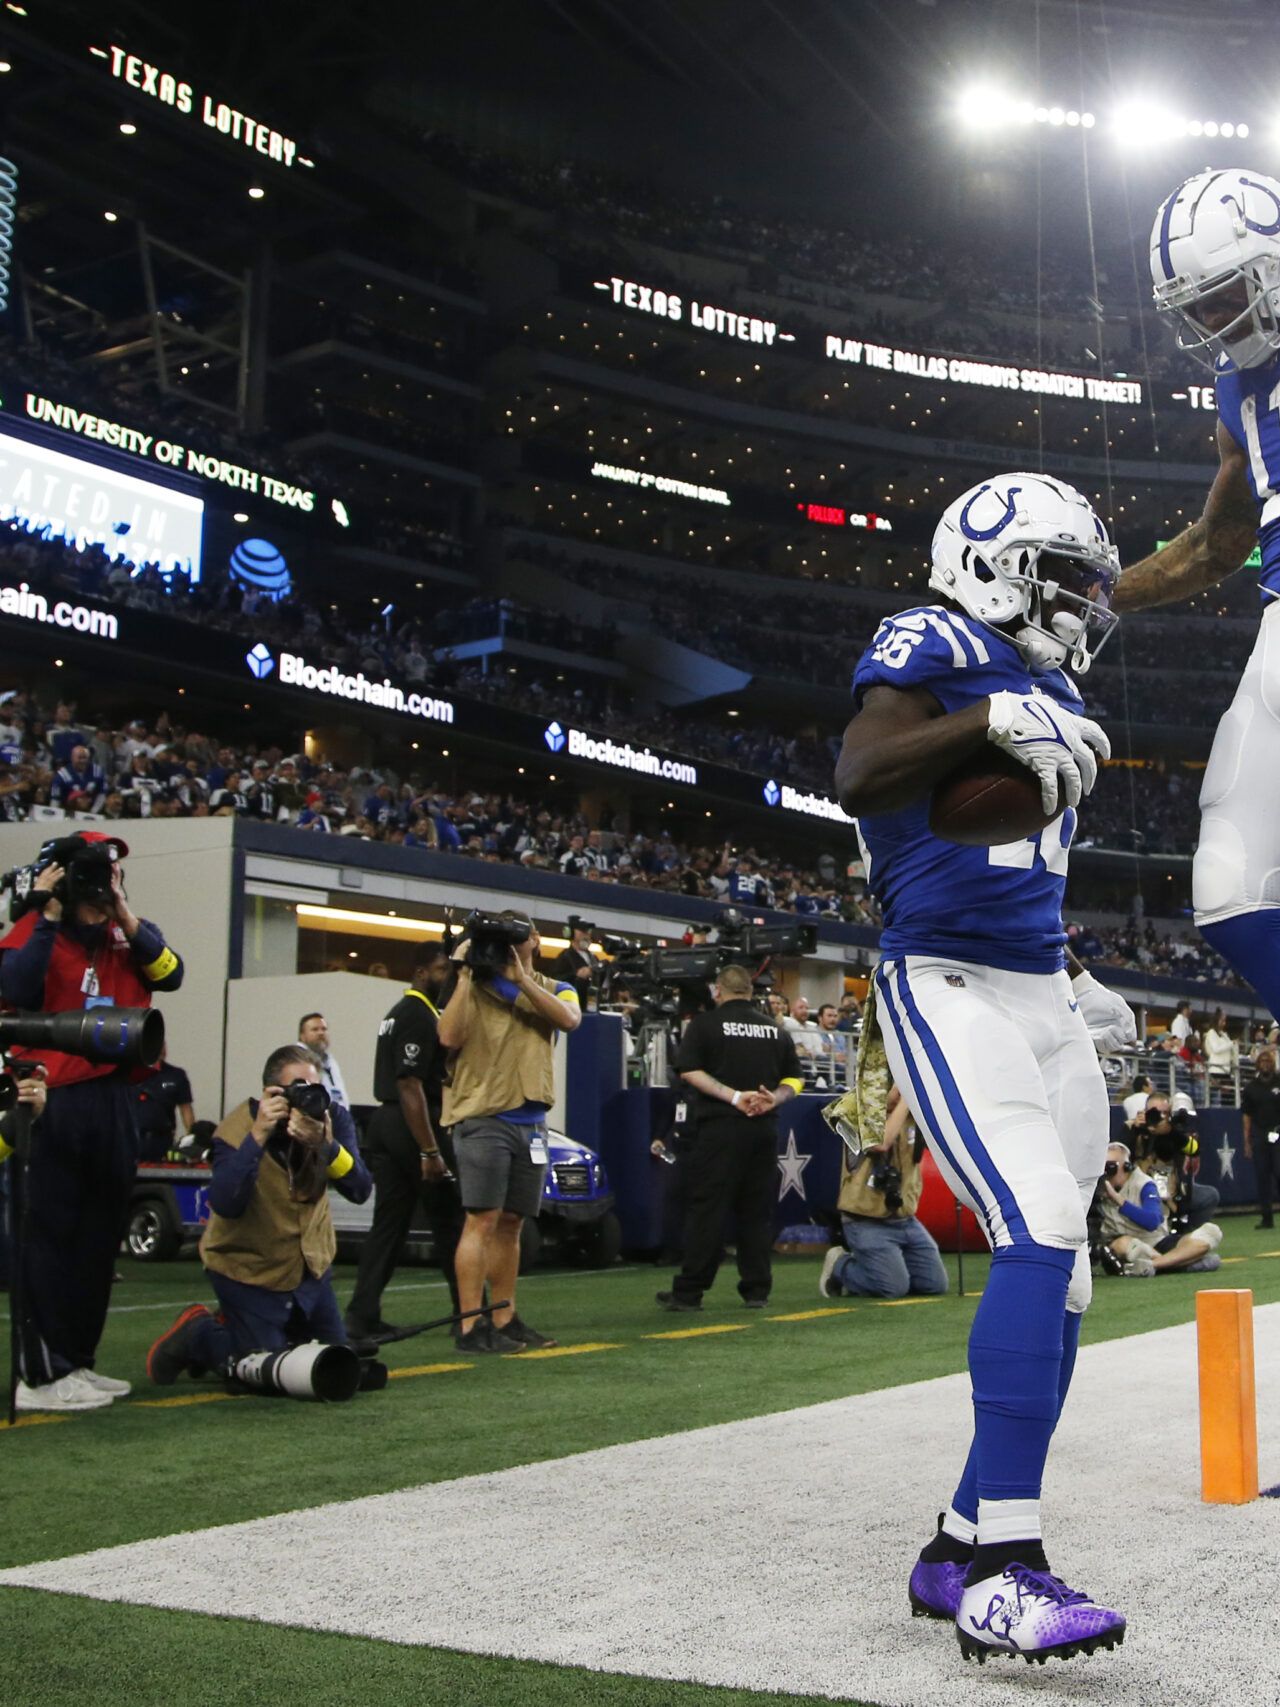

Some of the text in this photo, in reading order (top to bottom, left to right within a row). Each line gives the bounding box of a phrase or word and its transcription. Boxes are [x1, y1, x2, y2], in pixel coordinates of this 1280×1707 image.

[110, 45, 296, 167] TEXAS LOTTERY
[610, 277, 776, 346] TEXAS LOTTERY
[826, 335, 862, 363] PLAY
[863, 343, 892, 370] THE
[893, 349, 948, 380] DALLAS
[949, 358, 1020, 391] COWBOYS
[1020, 369, 1084, 399] SCRATCH
[26, 393, 315, 512] UNIVERSITY OF NORTH TEXAS
[0, 582, 118, 640] ain.com
[278, 652, 454, 725] Blockchain.com
[568, 729, 697, 785] Blockchain.com
[723, 1022, 778, 1039] SECURITY
